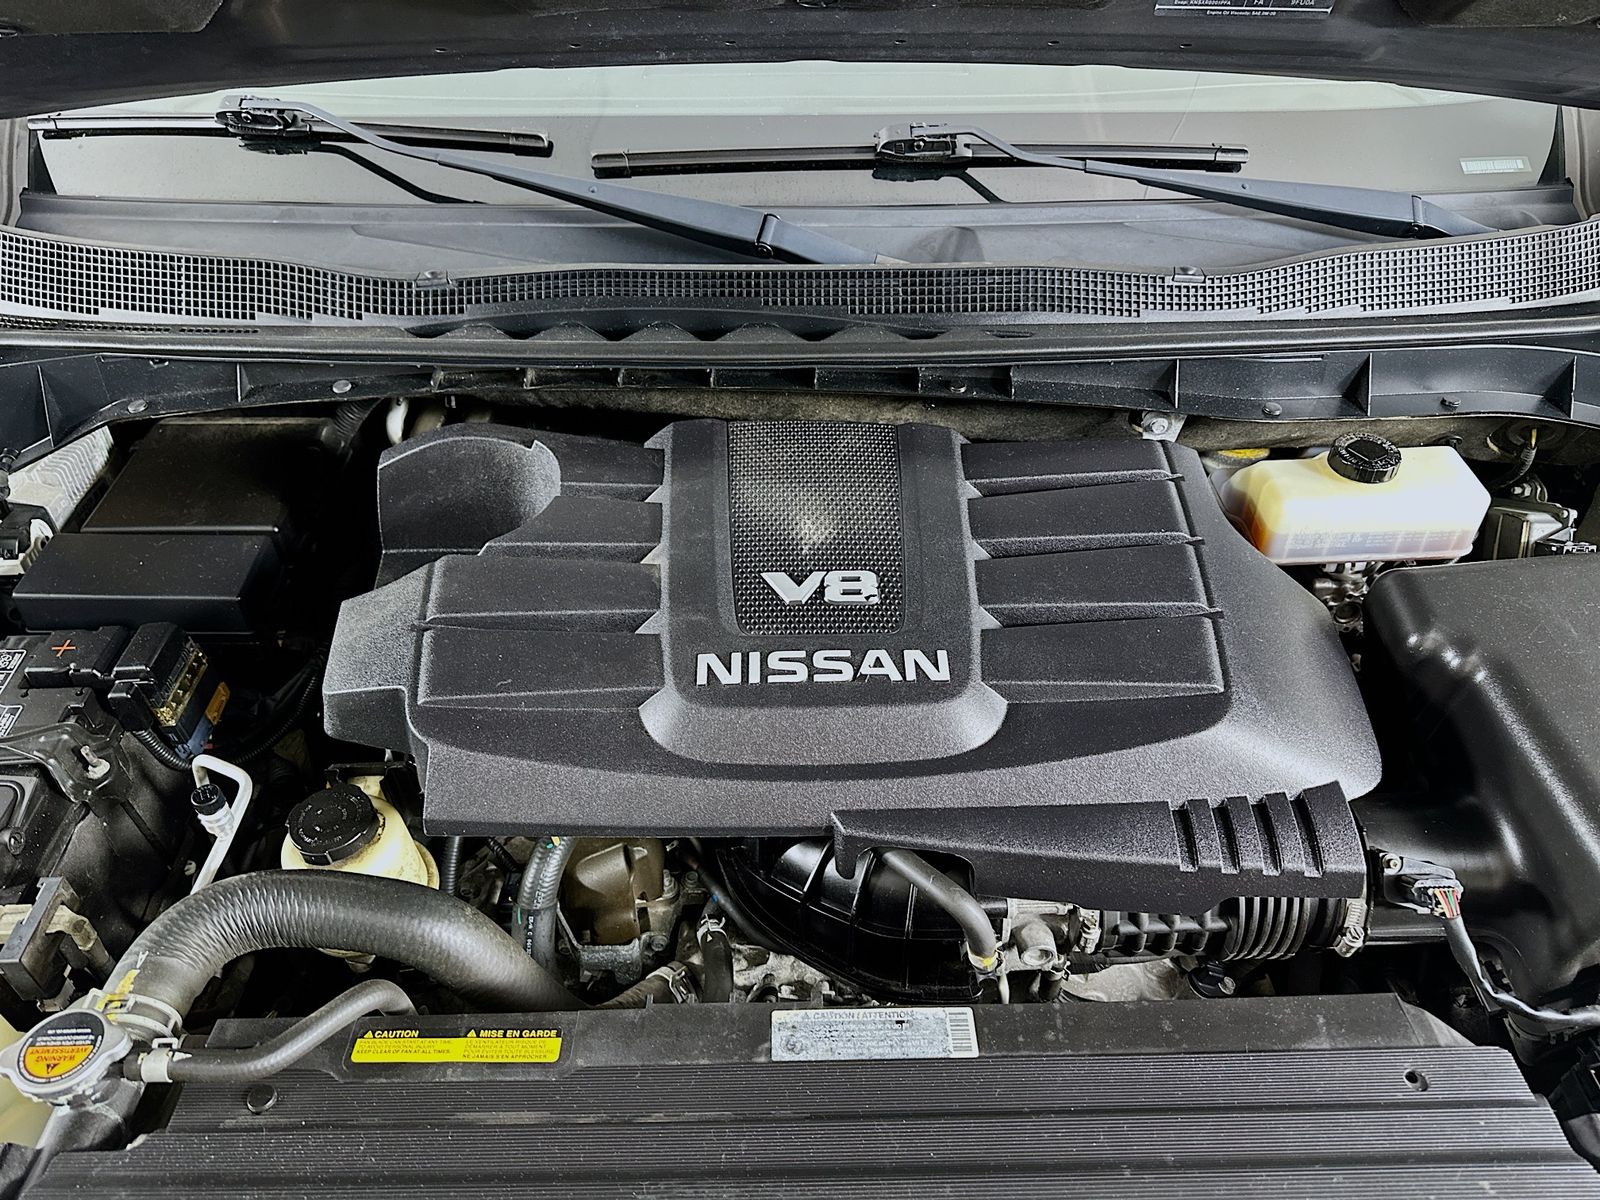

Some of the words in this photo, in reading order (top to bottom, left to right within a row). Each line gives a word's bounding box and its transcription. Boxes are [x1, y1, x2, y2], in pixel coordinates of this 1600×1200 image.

[760, 570, 880, 605] V8
[695, 649, 951, 686] NISSAN
[374, 1029, 419, 1038] CAUTION
[479, 1029, 505, 1038] MISE
[506, 1029, 521, 1038] EN
[522, 1029, 558, 1038] GARDE
